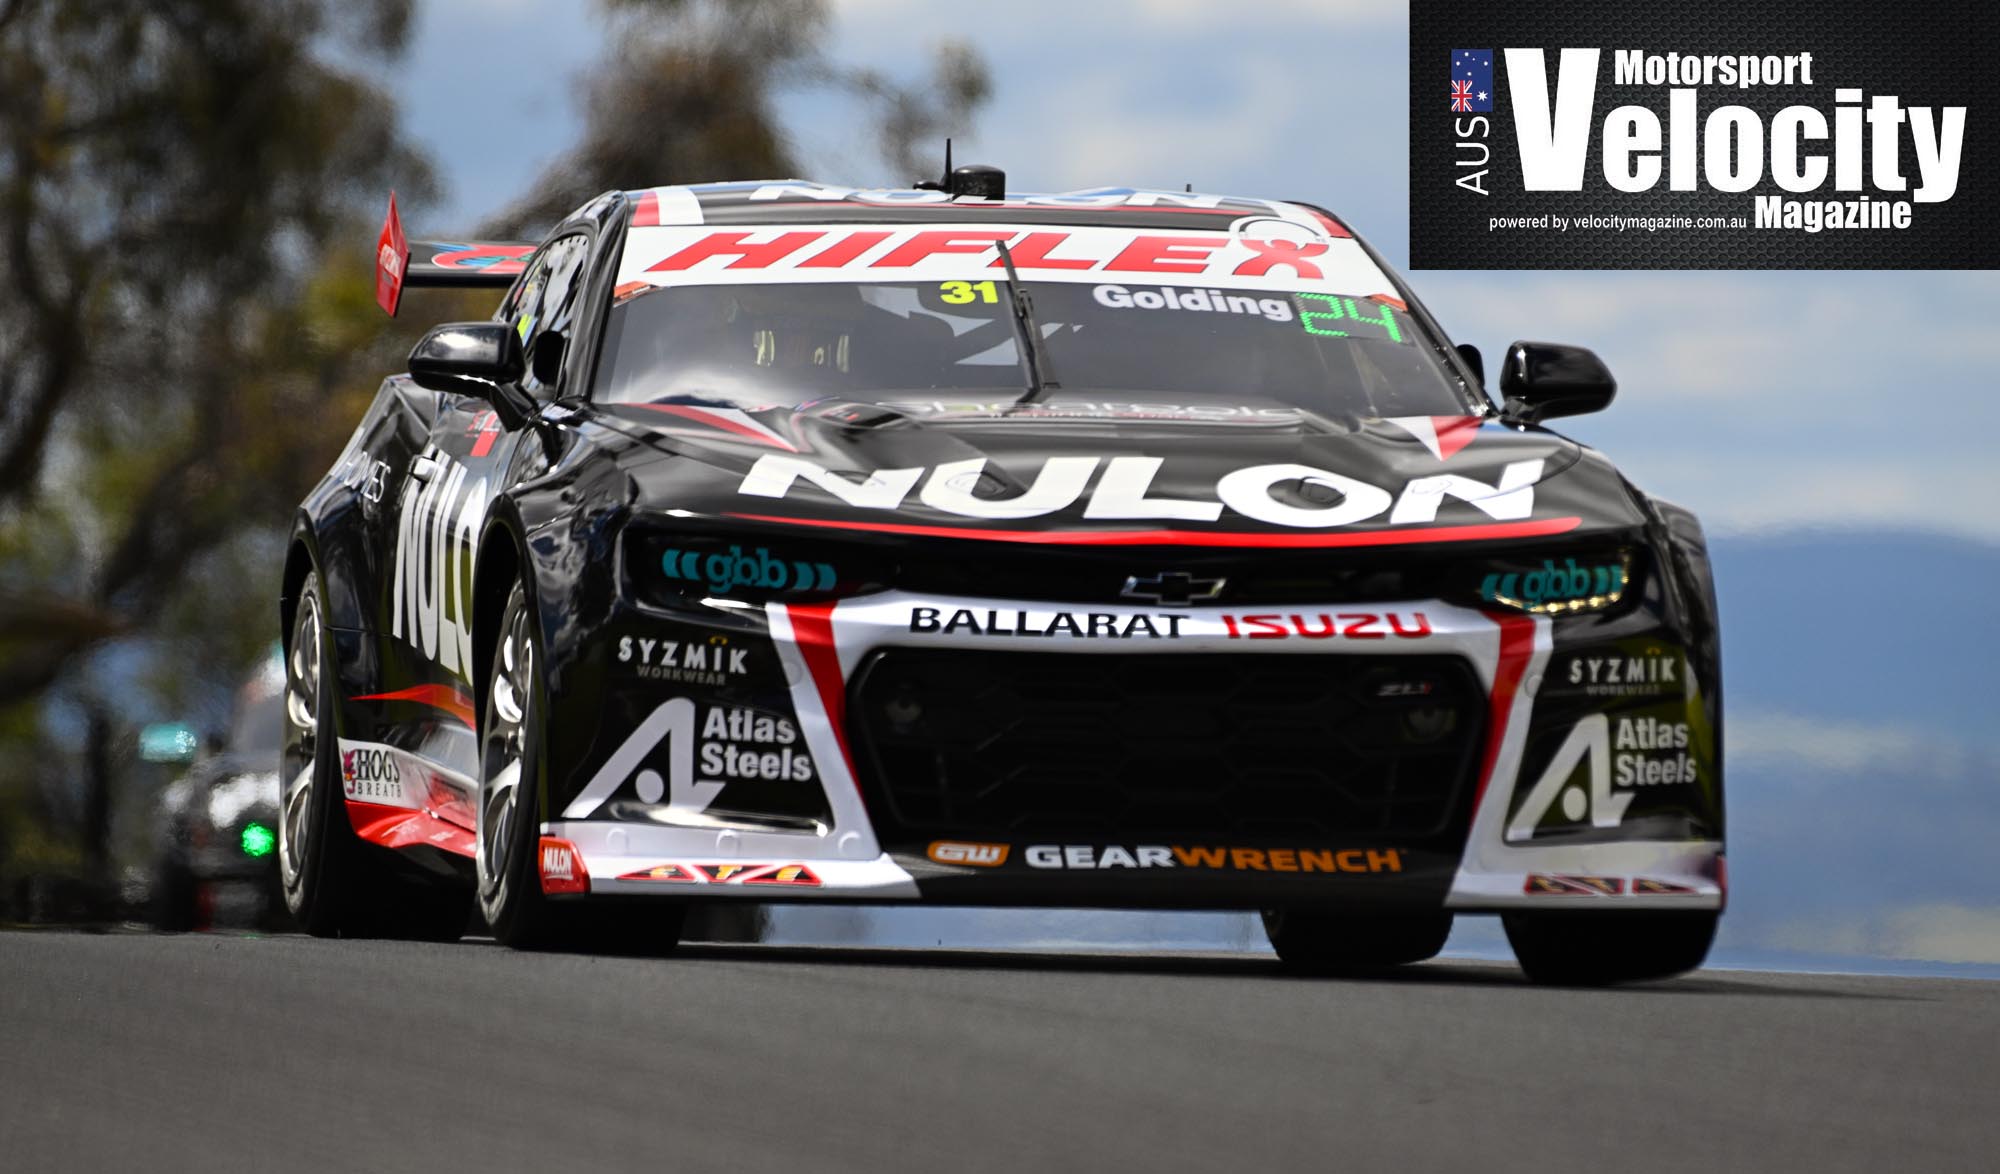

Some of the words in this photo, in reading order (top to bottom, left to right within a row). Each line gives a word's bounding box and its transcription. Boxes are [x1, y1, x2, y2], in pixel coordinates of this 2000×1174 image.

[644, 231, 1330, 280] HIFLEX
[939, 280, 999, 305] 31
[1092, 284, 1293, 322] Golding
[1296, 291, 1402, 343] 24
[738, 454, 1545, 527] NULON
[909, 607, 1190, 639] BALLARAT
[1220, 612, 1433, 640] ISUZU
[618, 634, 749, 675] SYZMIK
[1569, 656, 1677, 685] SYZMIK
[636, 664, 726, 686] WORKWEAR
[702, 706, 797, 745] Atlas
[1616, 717, 1689, 751] Atlas
[355, 749, 401, 784] HOGS
[700, 742, 813, 782] Steels
[1616, 752, 1697, 788] Steels
[543, 847, 573, 875] NULON
[1025, 844, 1401, 873] GEARWRENCH
